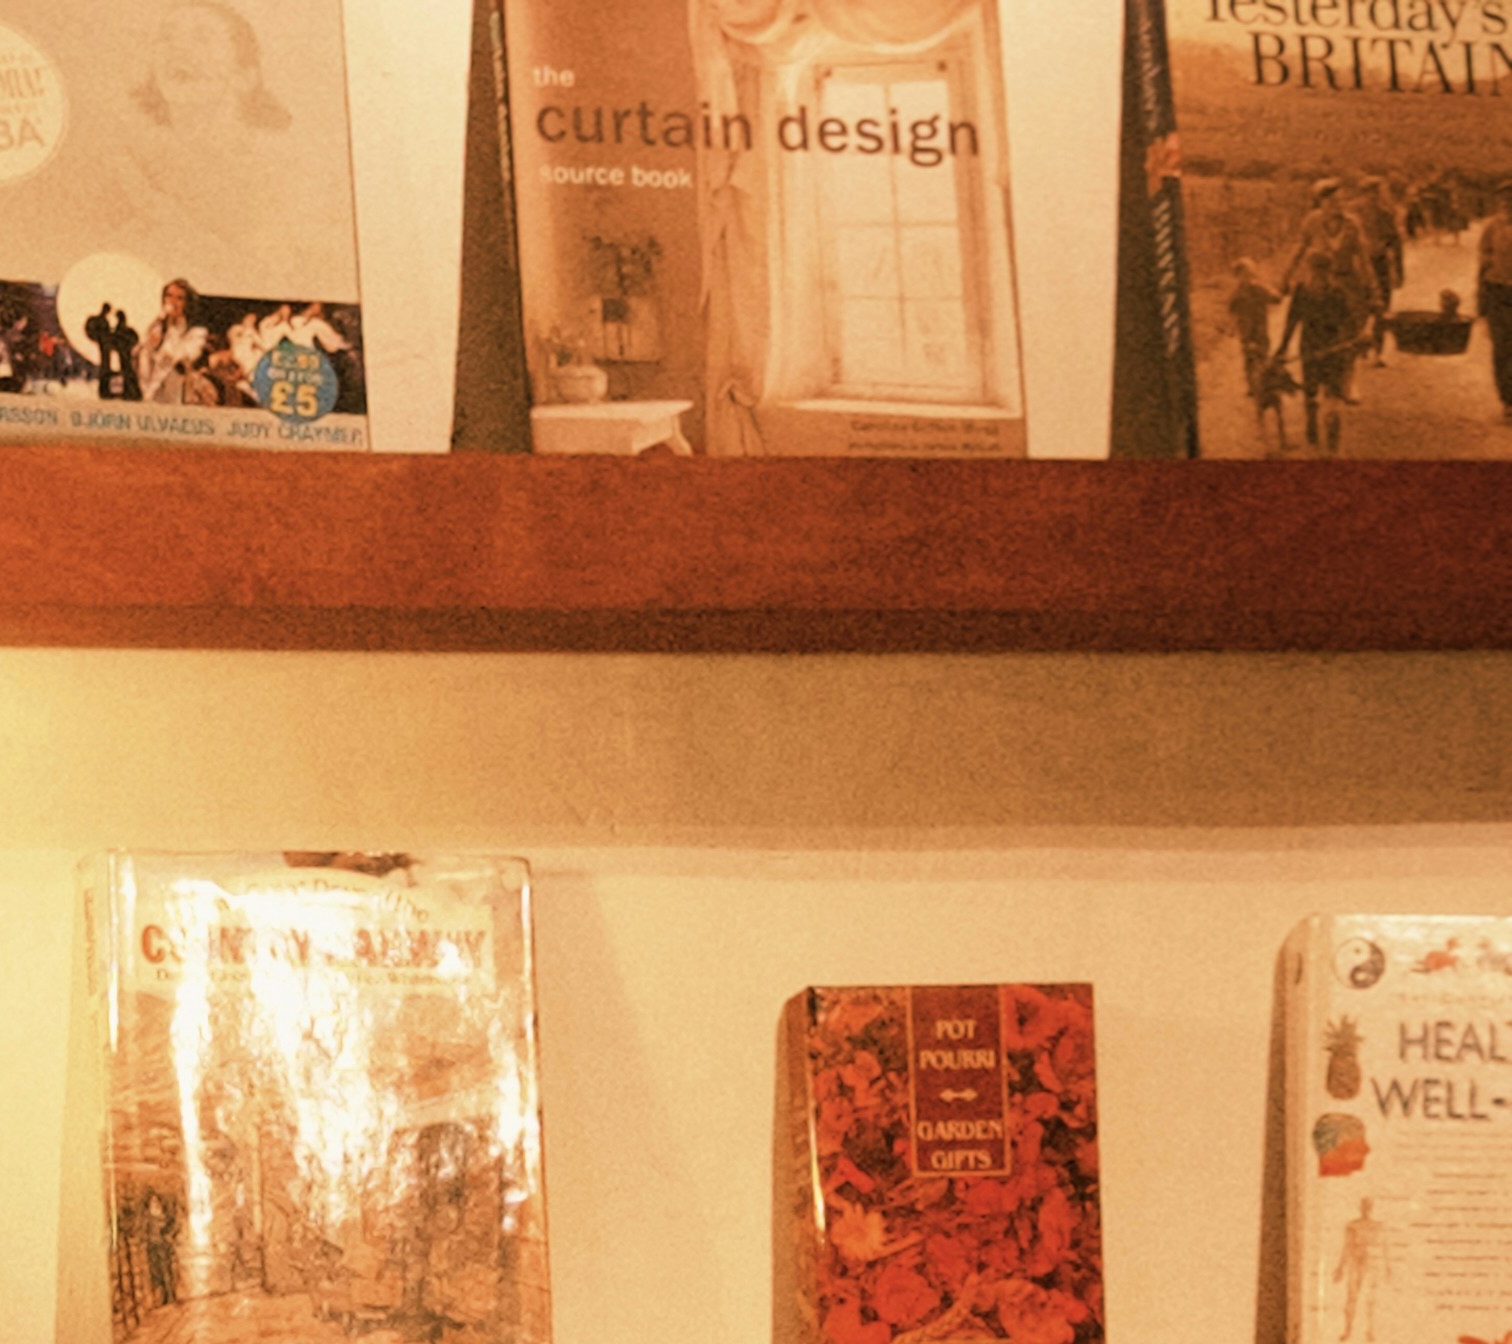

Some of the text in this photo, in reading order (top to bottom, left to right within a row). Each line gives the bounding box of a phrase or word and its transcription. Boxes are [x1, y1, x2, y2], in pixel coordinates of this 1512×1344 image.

[533, 66, 574, 90] the
[535, 101, 980, 168] curtain design
[540, 163, 693, 189] source book
[270, 380, 318, 417] £5
[936, 1019, 976, 1040] POT
[1399, 1021, 1512, 1064] HEAL
[919, 1049, 996, 1071] POURRI
[917, 1120, 1003, 1142] GARDEN
[931, 1149, 991, 1171] GIFTS
